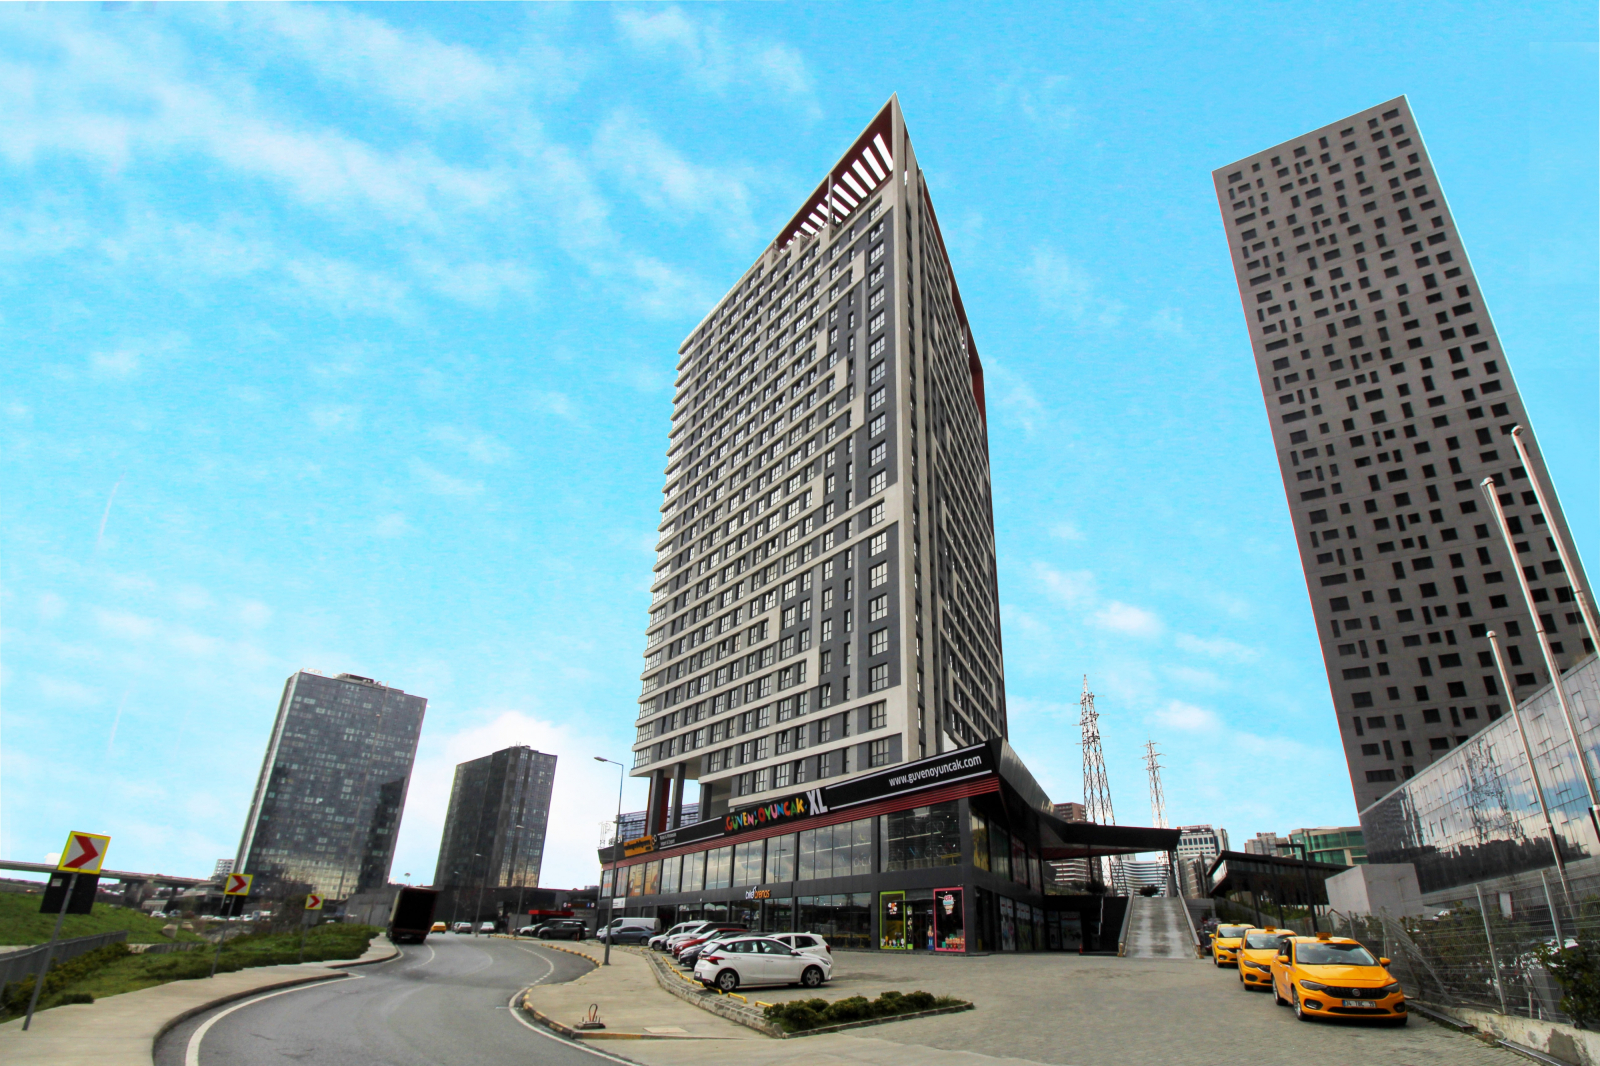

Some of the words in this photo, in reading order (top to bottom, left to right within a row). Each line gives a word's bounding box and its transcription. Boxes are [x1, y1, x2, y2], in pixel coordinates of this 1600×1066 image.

[889, 755, 982, 787] www.guvenoyuncak.com
[726, 812, 754, 831] GÜVEN
[757, 798, 805, 822] OYUNCAK
[806, 788, 828, 816] XL
